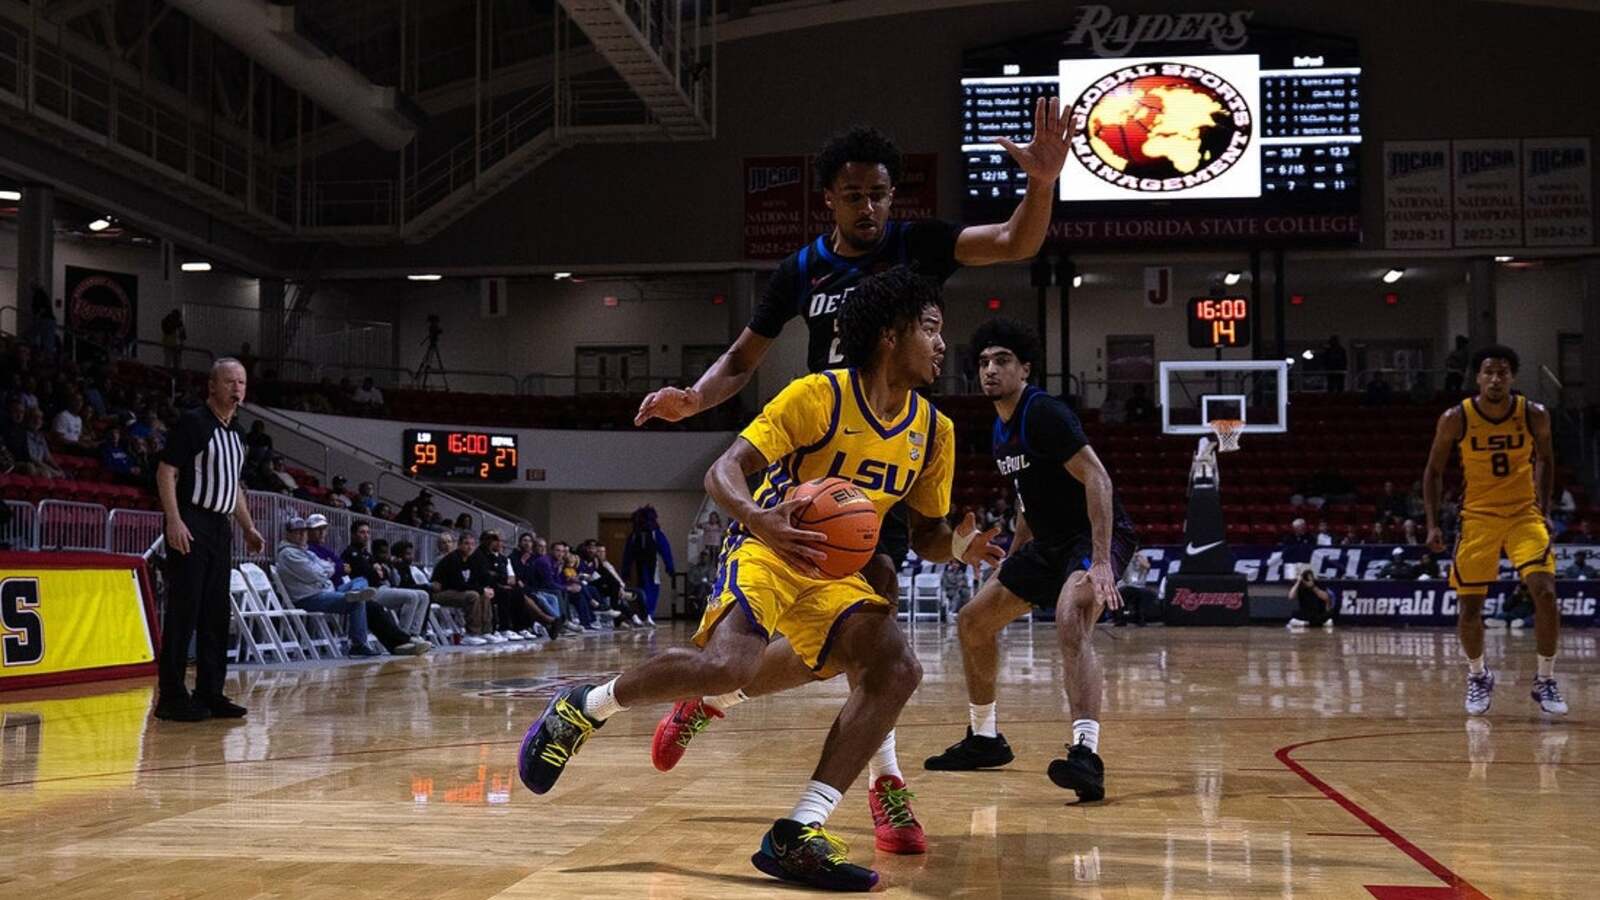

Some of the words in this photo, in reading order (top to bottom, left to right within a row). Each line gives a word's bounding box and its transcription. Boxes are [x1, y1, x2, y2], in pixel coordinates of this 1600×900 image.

[1072, 65, 1155, 130] GLOBAL
[1161, 64, 1250, 127] SPORTS
[1070, 131, 1249, 191] MANAGEMENT
[1043, 220, 1097, 238] WEST
[1104, 218, 1195, 237] FLORIDA
[1200, 216, 1260, 235] STATE
[1264, 214, 1358, 233] COLLEGE
[1149, 268, 1168, 305] J
[1196, 299, 1246, 320] 16:00
[1213, 320, 1235, 344] 14
[414, 444, 436, 464] 59
[448, 433, 488, 454] 16:00
[1471, 433, 1525, 451] LSU
[494, 448, 516, 467] 27
[1492, 453, 1510, 477] 8
[480, 463, 489, 478] 2
[825, 451, 917, 498] LSU
[1340, 590, 1436, 615] Emerald
[1441, 590, 1506, 615] Cst
